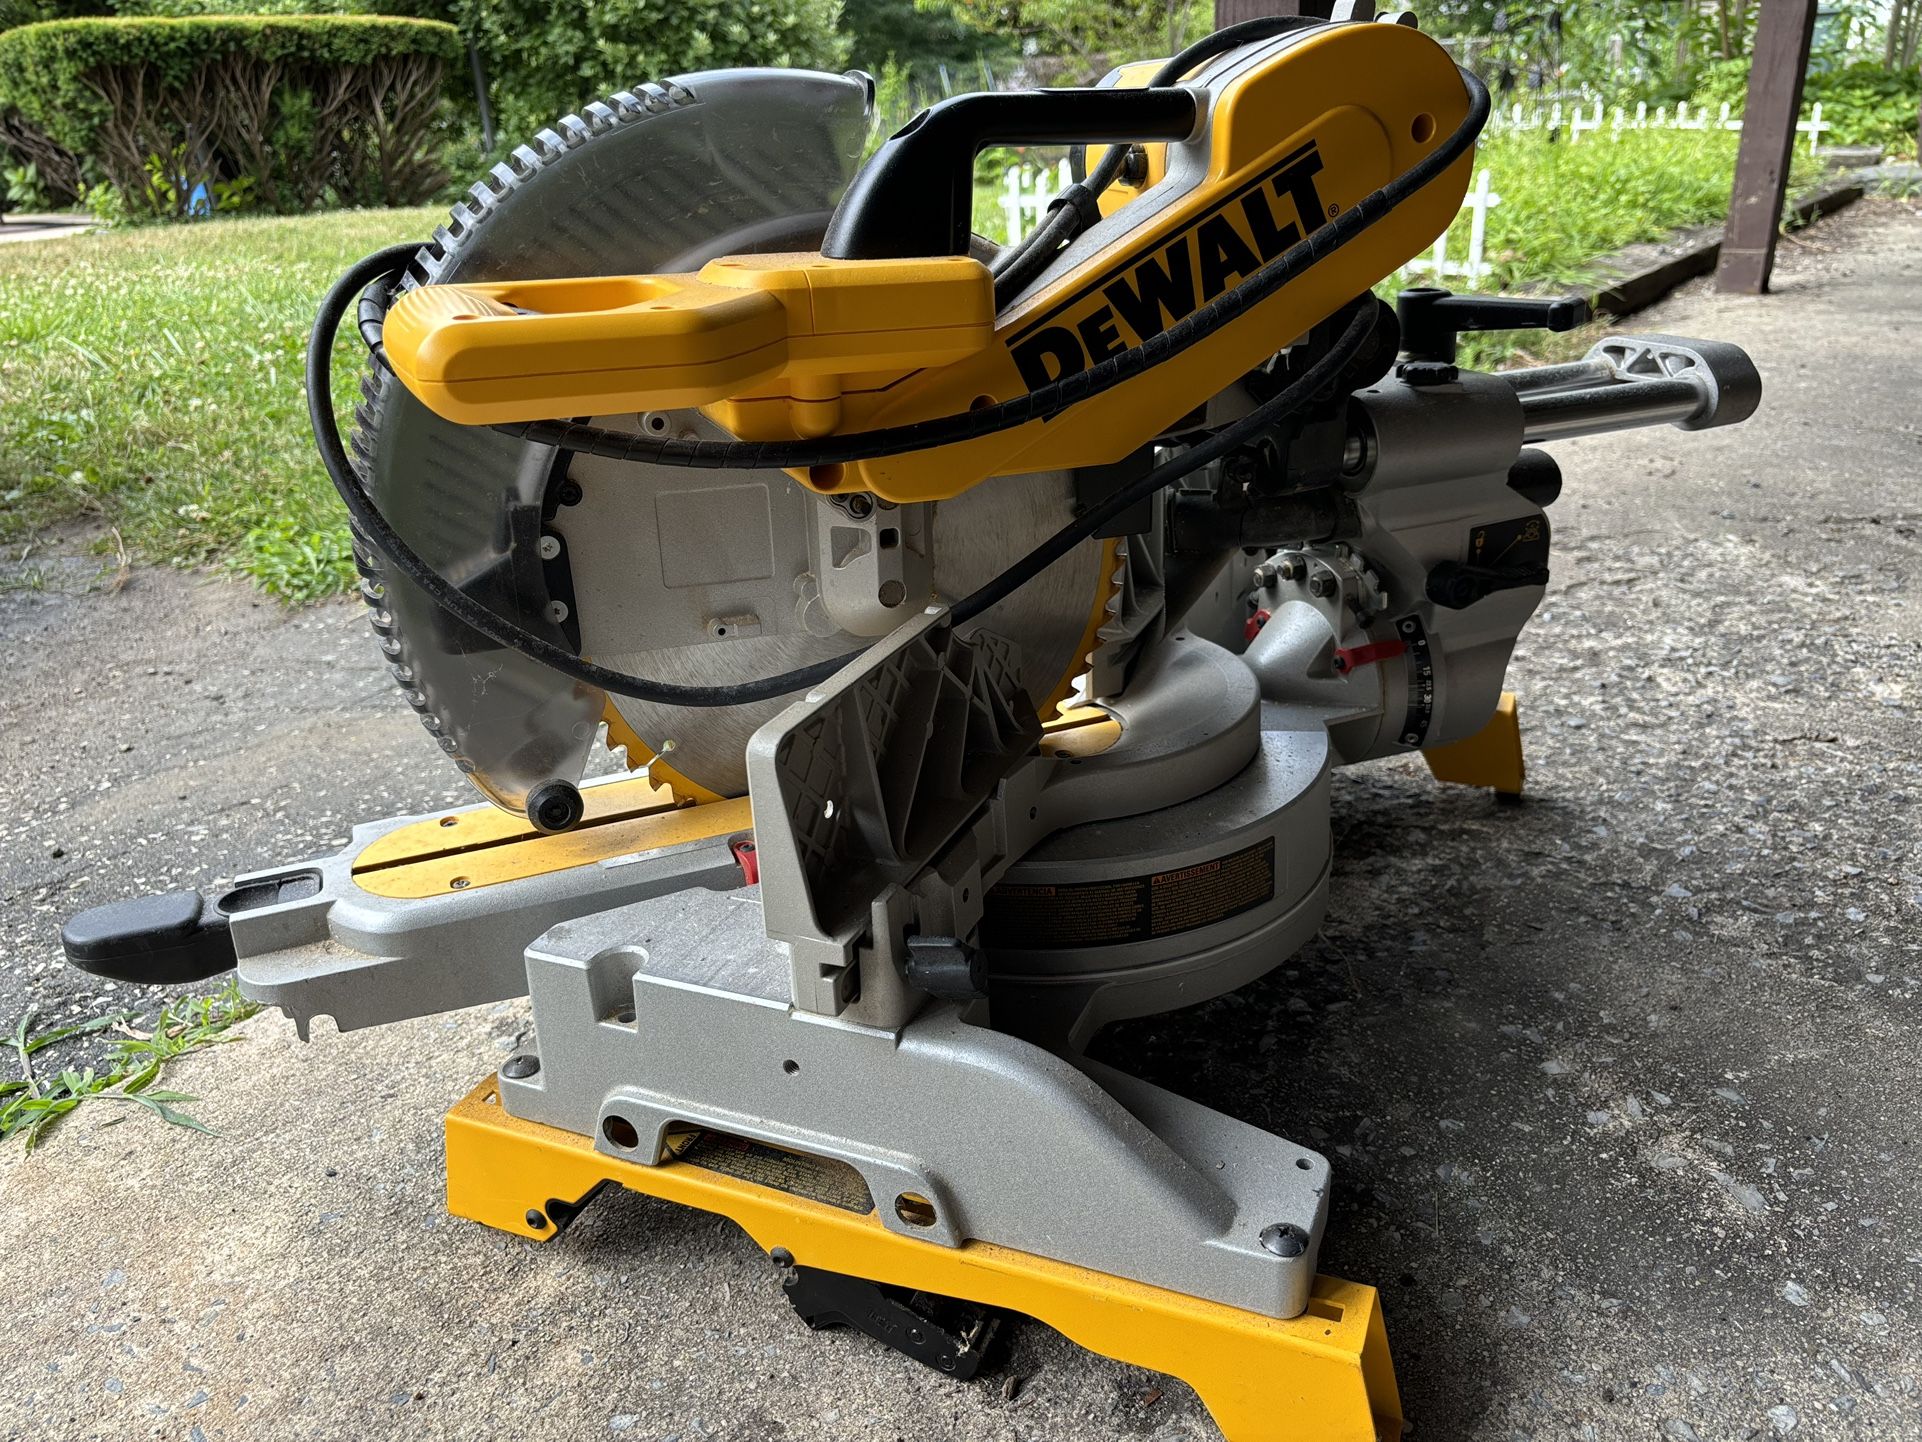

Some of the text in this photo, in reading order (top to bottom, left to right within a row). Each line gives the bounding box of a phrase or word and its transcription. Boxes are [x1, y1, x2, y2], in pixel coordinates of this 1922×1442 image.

[1010, 149, 1324, 424] DEWALT
[1423, 666, 1432, 676] 15
[1160, 862, 1219, 883] AVERTISSEMENT
[674, 1132, 697, 1154] FRONT
